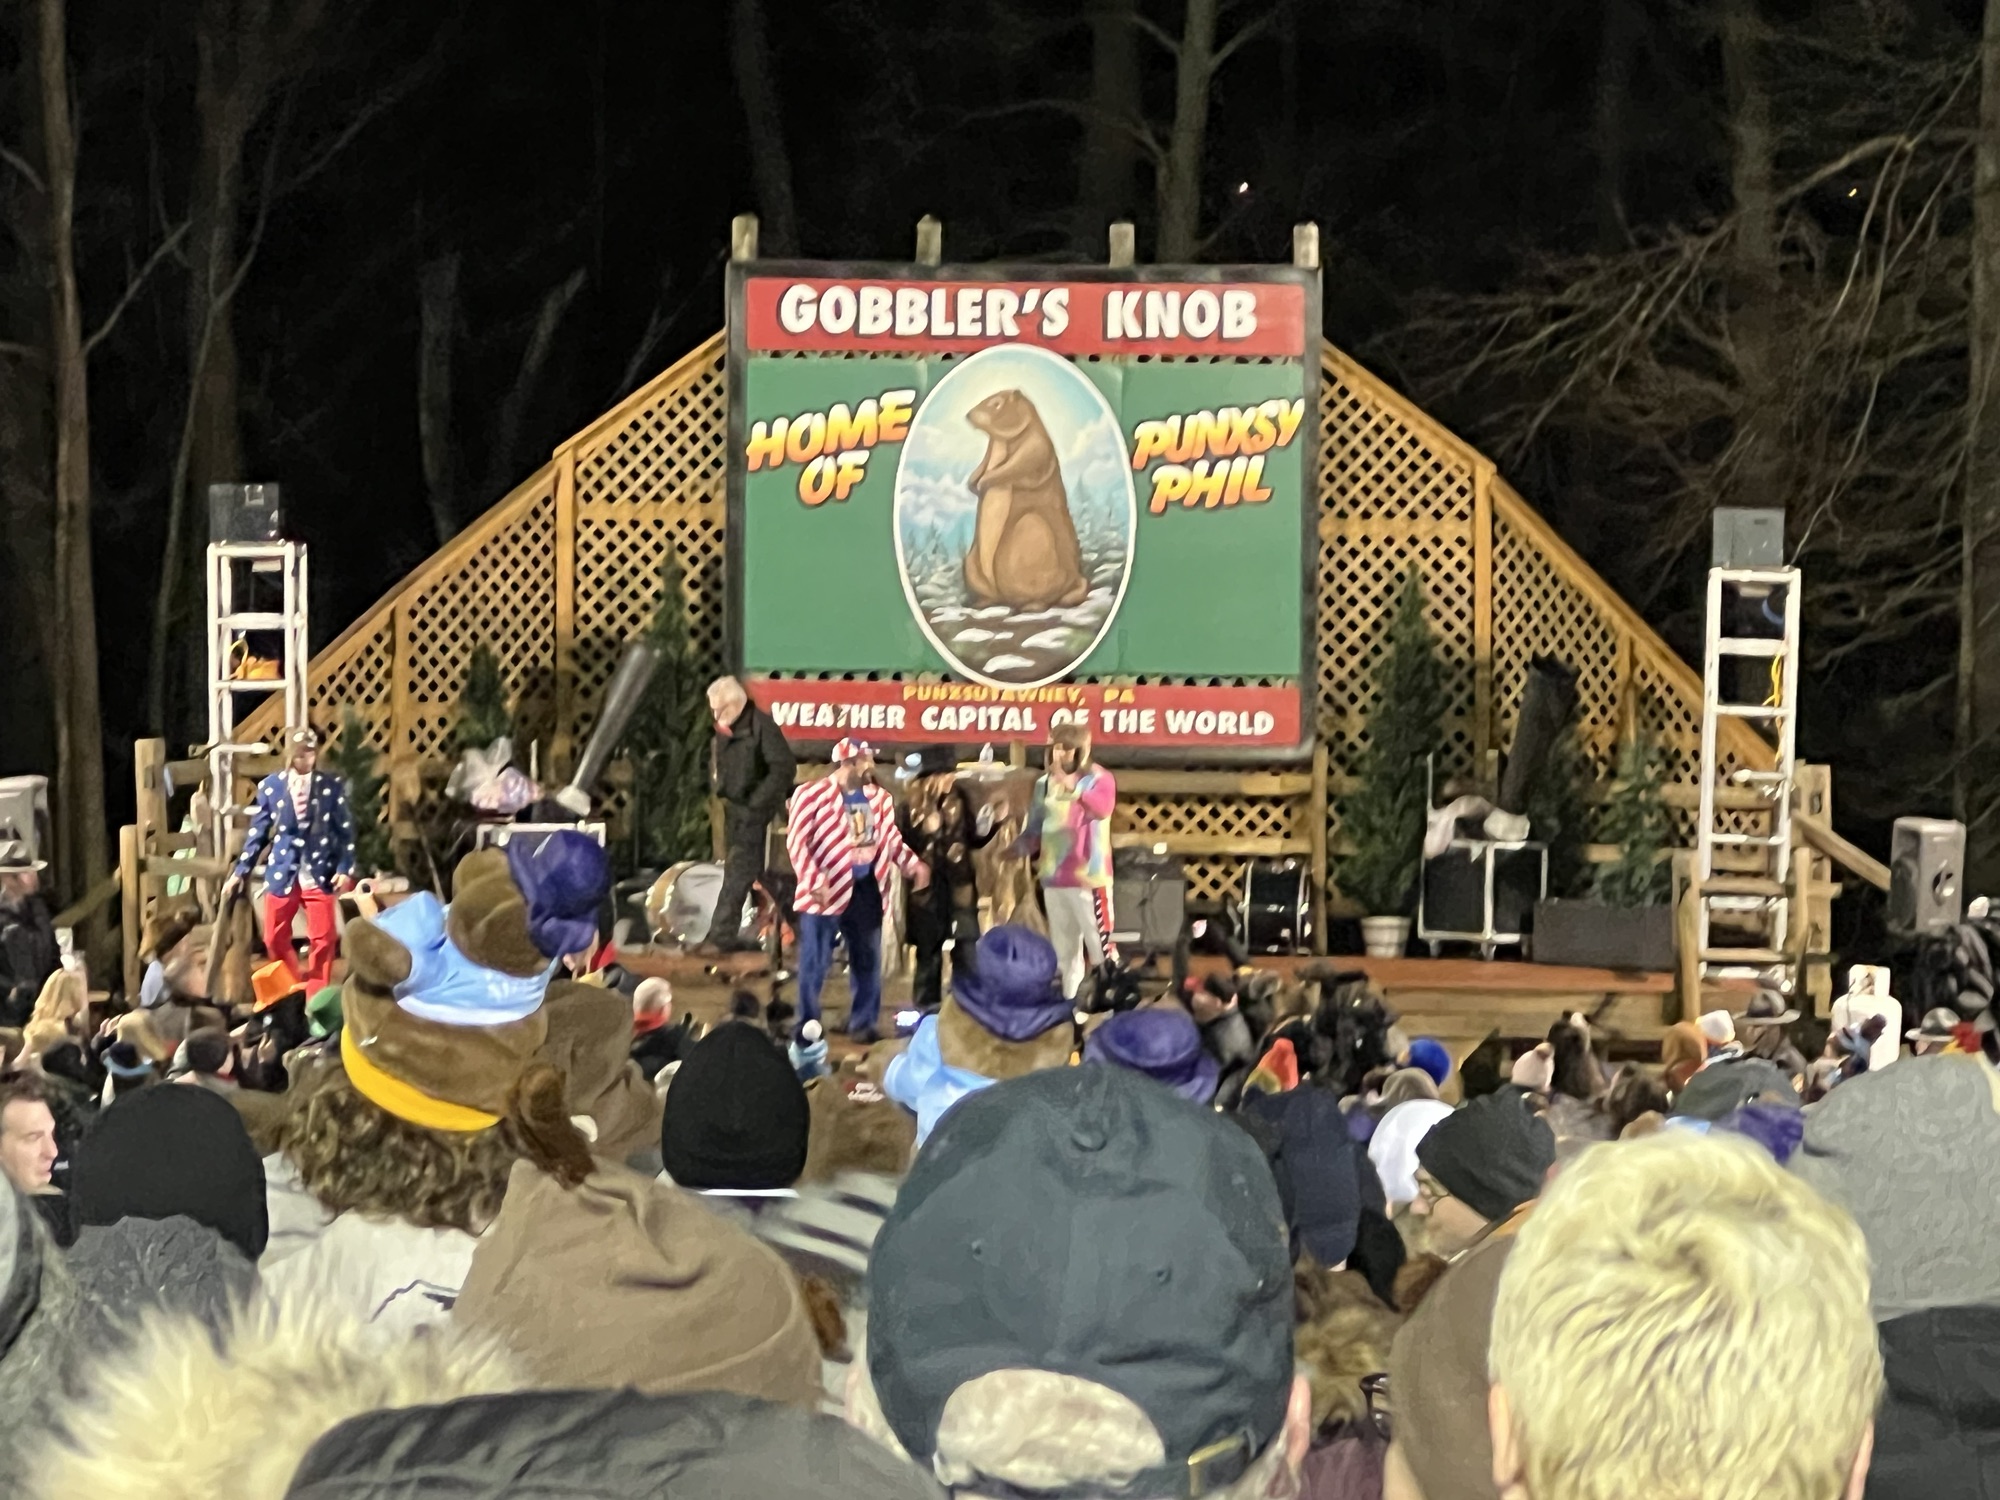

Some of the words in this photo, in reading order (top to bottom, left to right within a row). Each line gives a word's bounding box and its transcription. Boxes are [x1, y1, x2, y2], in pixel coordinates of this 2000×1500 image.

[780, 283, 1071, 338] GOBBLER'S
[1105, 286, 1260, 341] KNOB
[745, 389, 917, 472] HOME
[1131, 397, 1306, 470] PUNXSY
[798, 449, 872, 507] OF
[1148, 453, 1274, 515] PHIL
[770, 701, 907, 730] WEATHER
[920, 705, 1038, 732] CAPITAL
[1099, 708, 1157, 734] THE
[1164, 709, 1276, 737] WORLD
[1103, 687, 1136, 704] PA
